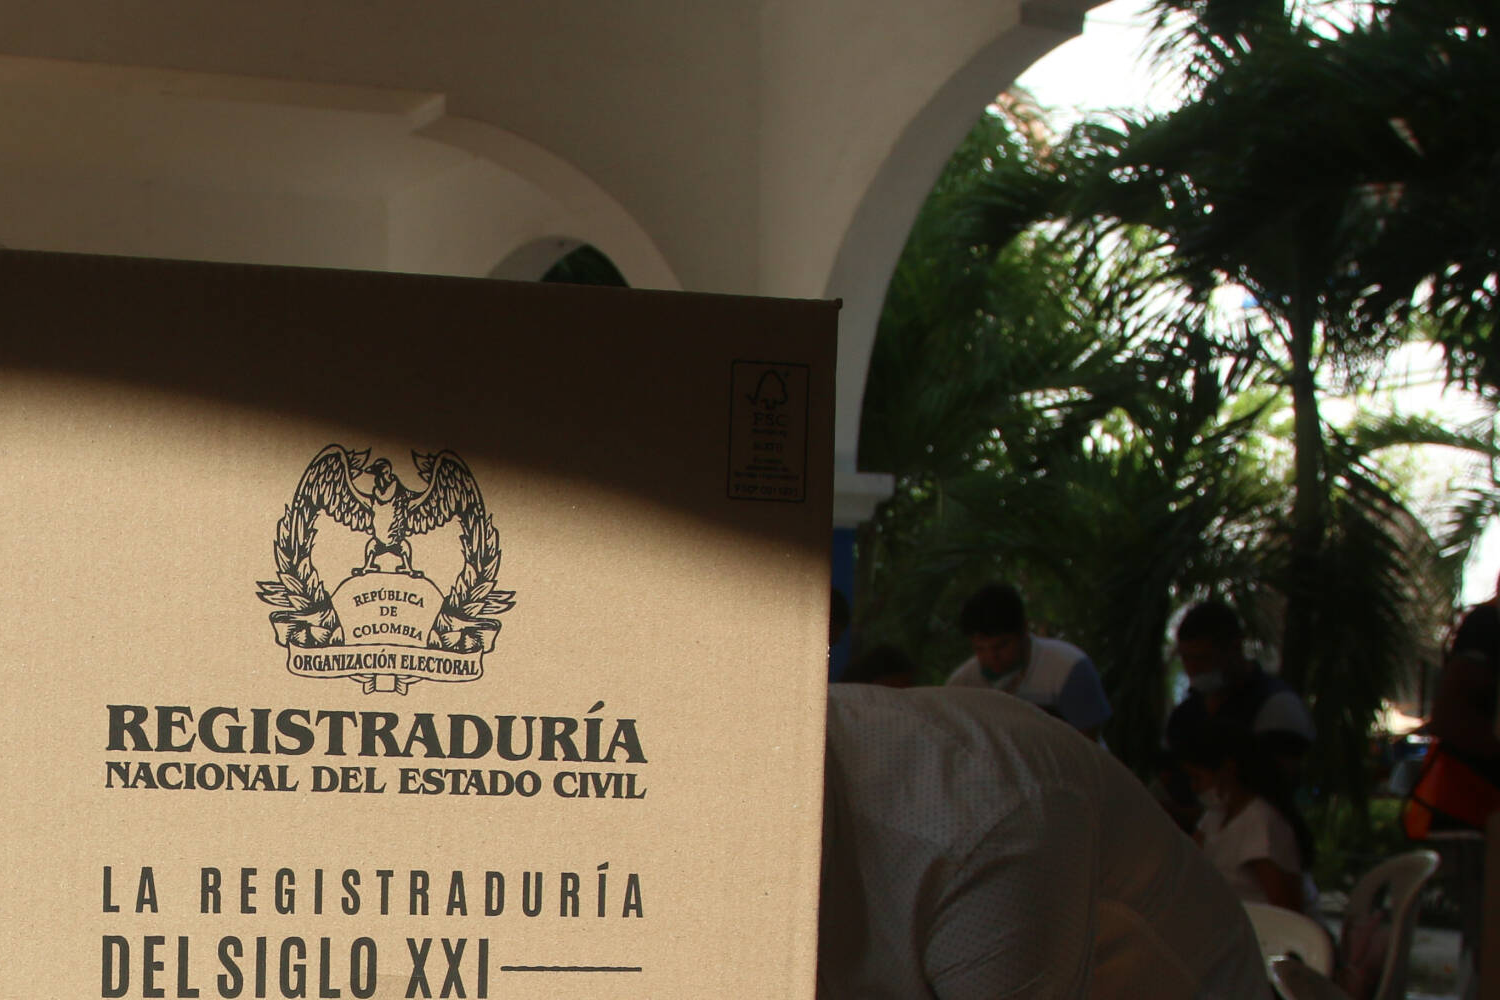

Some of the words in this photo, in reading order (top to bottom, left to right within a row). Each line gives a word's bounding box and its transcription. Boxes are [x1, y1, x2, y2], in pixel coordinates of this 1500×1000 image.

[353, 587, 425, 608] REPÚBLICA
[380, 606, 397, 617] DE
[353, 622, 423, 641] COLOMBIA
[293, 648, 397, 672] ORGANIZACIÓN
[400, 655, 479, 676] ELECTORAL
[105, 700, 648, 764] REGISTRADURÍA
[105, 762, 299, 793] NACIONAL
[311, 765, 386, 794] DEL
[399, 768, 542, 797] ESTADO
[553, 771, 648, 799] CIVIL
[102, 865, 159, 913] LA
[200, 861, 645, 918] REGISTRADURÍA
[102, 935, 200, 998] DEL
[216, 935, 378, 998] SIGLO
[404, 937, 489, 999] XXI
